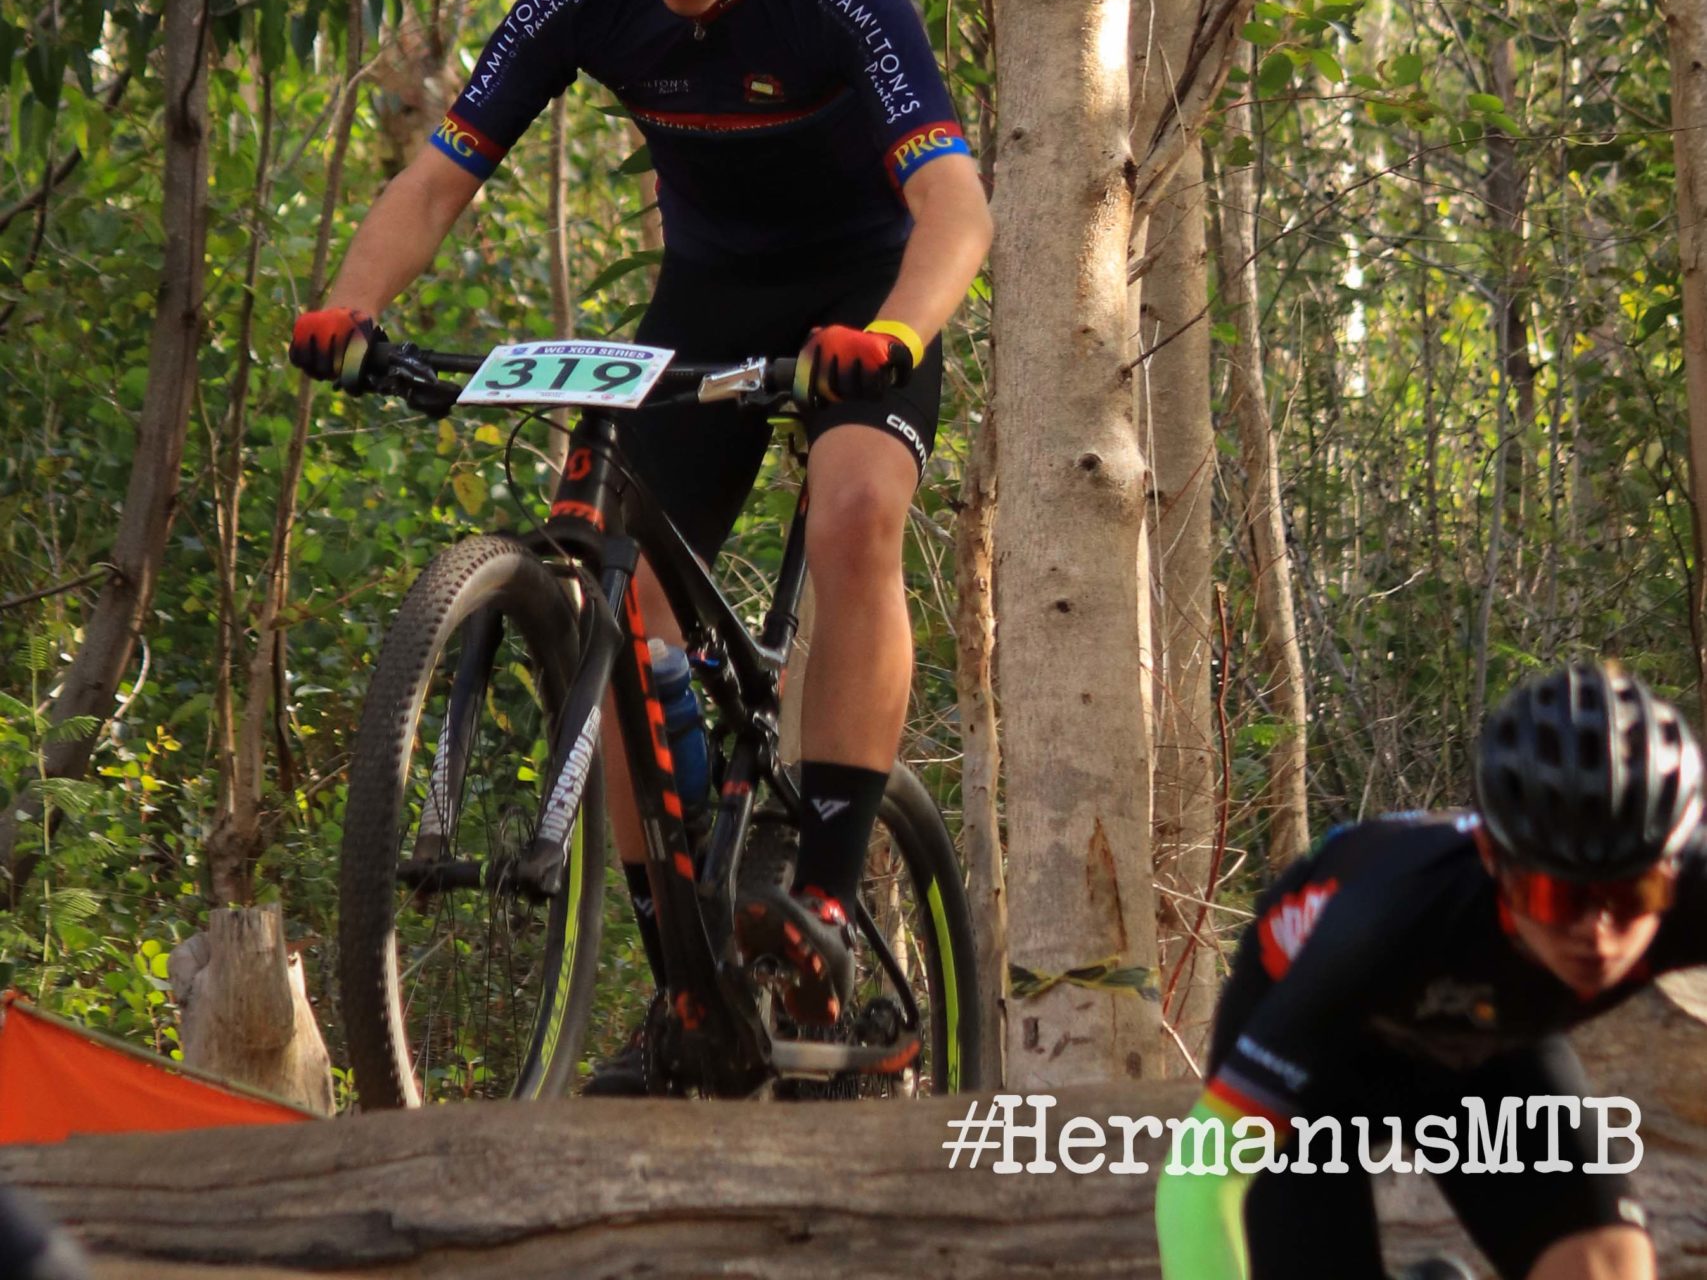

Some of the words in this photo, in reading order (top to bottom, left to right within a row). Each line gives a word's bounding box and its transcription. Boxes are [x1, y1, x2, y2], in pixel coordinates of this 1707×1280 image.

[893, 127, 953, 170] PRG
[598, 347, 646, 359] SERIES
[484, 357, 643, 392] 319
